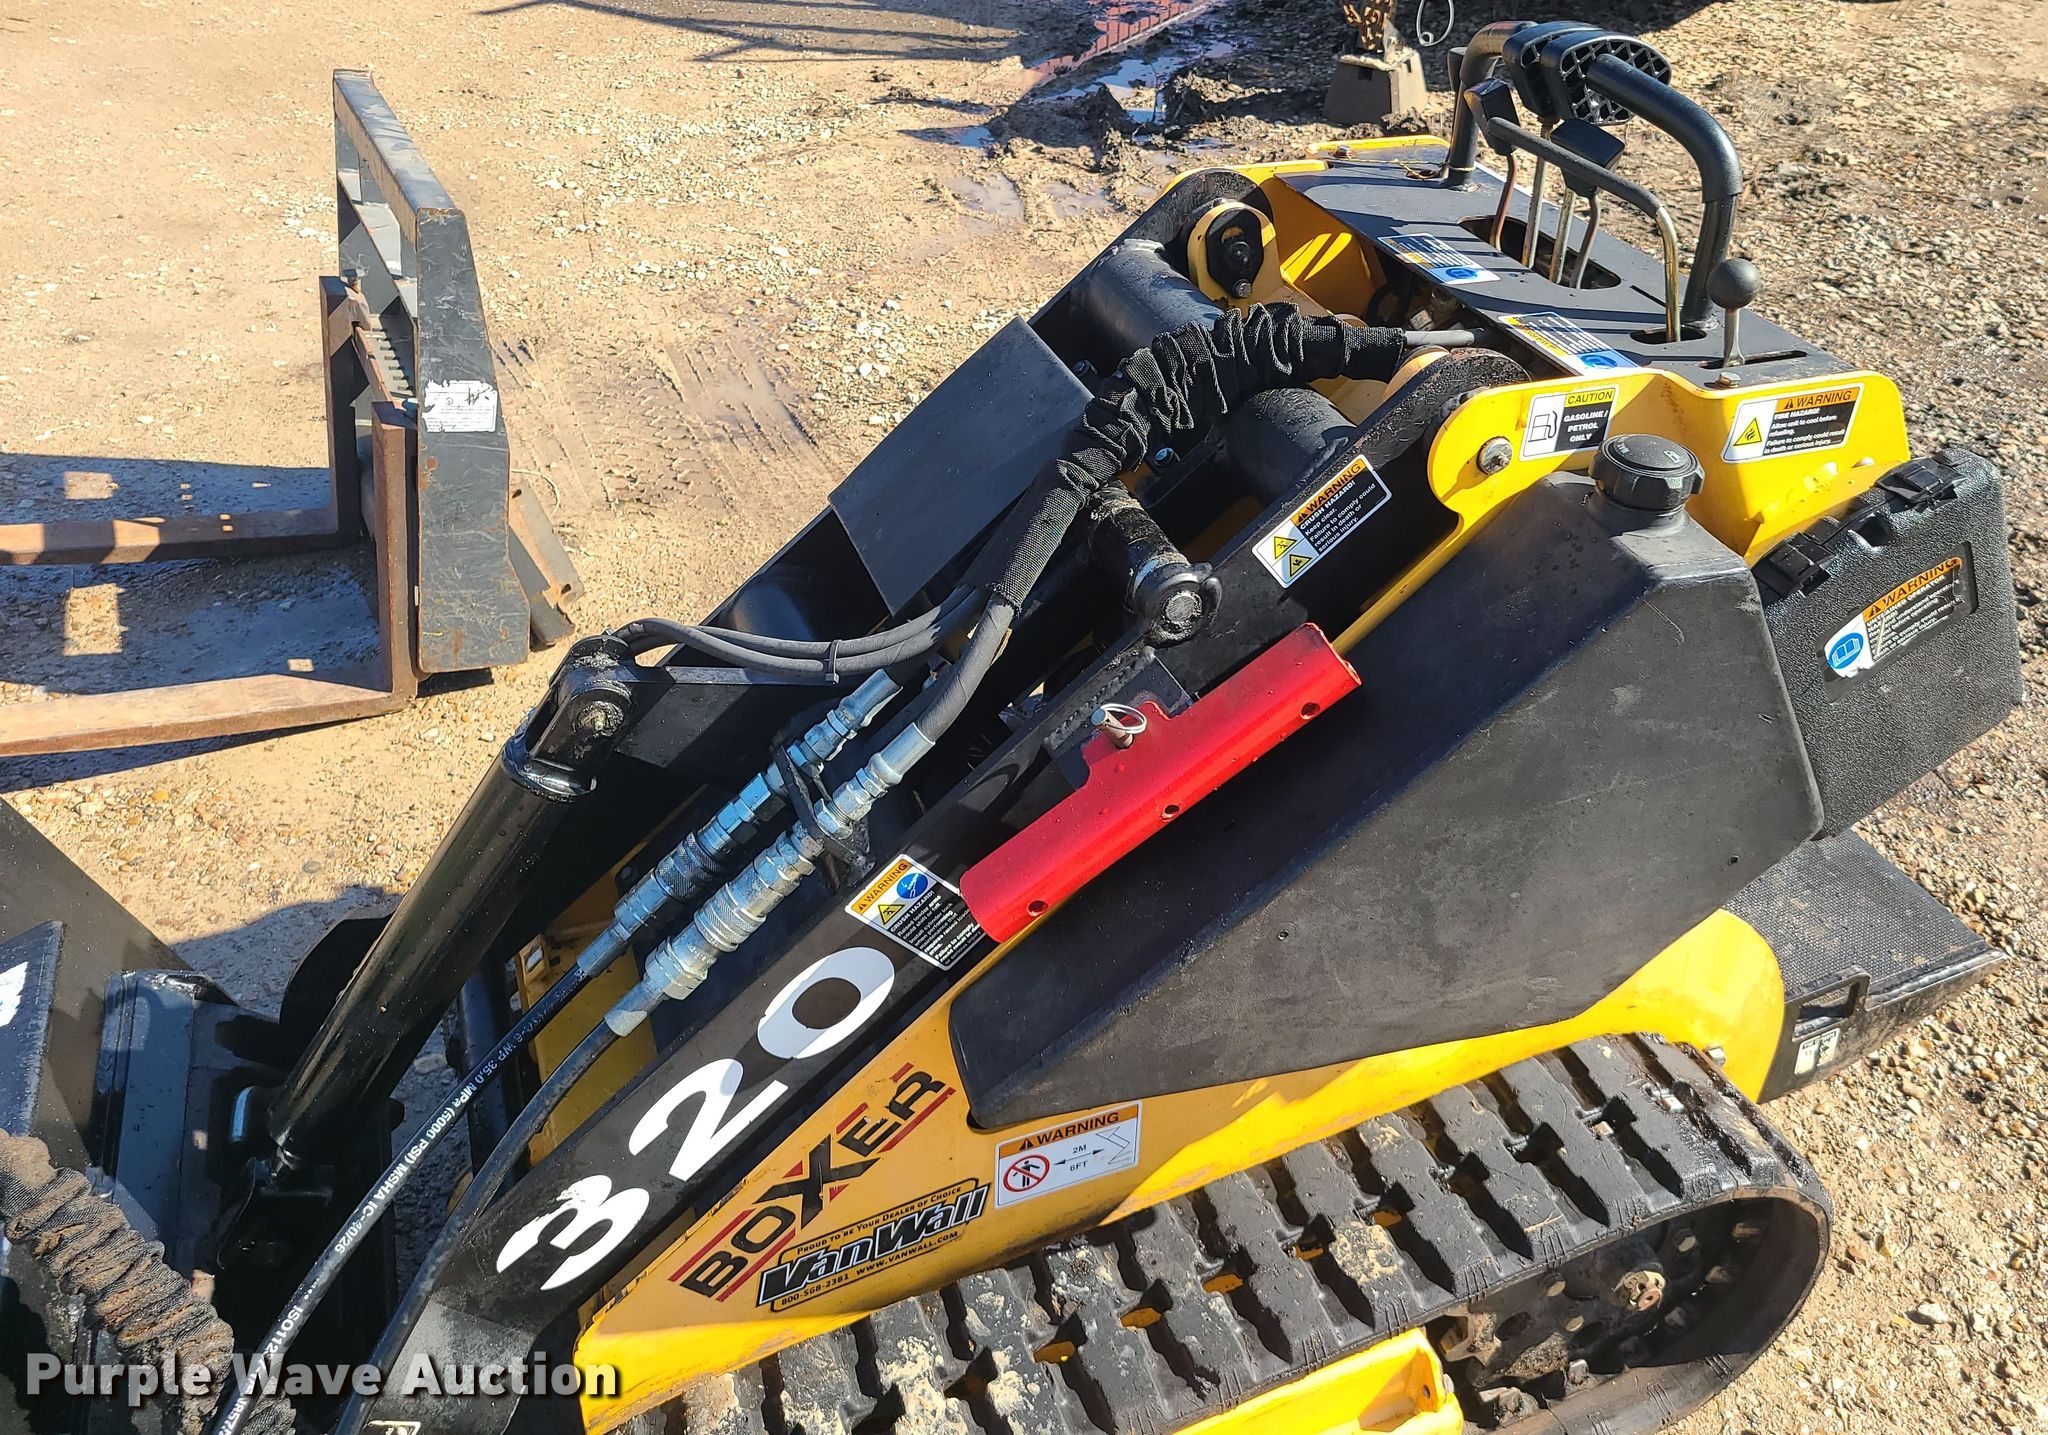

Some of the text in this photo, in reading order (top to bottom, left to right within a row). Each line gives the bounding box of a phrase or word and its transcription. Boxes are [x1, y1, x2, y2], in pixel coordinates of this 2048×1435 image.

[1568, 390, 1612, 404] CAUTION
[1796, 390, 1851, 406] WARNING
[1567, 422, 1598, 432] PETROL
[1570, 433, 1592, 442] ONLY
[1299, 480, 1355, 529] CRUSH HAZARD!
[1306, 463, 1360, 512] WARNING
[1305, 507, 1337, 535] Keep clear.
[1310, 522, 1330, 541] Failure
[1337, 497, 1359, 518] comply
[1358, 483, 1375, 499] could
[1314, 530, 1331, 546] result
[1337, 510, 1354, 525] death
[1318, 516, 1358, 551] serious injury.
[1883, 557, 1956, 606] WARNING
[1906, 574, 1945, 600] OPERATOR
[864, 862, 907, 903] WARNING
[890, 890, 934, 932] CRUSH HAZARD!
[897, 894, 941, 936] Raised loader arms
[902, 925, 916, 939] could
[915, 915, 927, 926] shift
[908, 902, 952, 943] Install cylinder lock
[914, 909, 953, 946] when performing
[919, 912, 957, 949] maintenance that
[923, 908, 970, 953] requires raised loade
[934, 943, 951, 959] Failure
[956, 922, 974, 940] comply
[494, 1040, 514, 1061] WP
[450, 1081, 477, 1110] MPa
[423, 1105, 456, 1141] (5000
[496, 946, 895, 1291] 320
[1037, 1112, 1119, 1145] WARNING
[402, 1136, 429, 1164] PSI)
[1070, 1161, 1088, 1171] 6FT
[1073, 1144, 1087, 1153] 2M
[372, 1162, 408, 1202] MSHA
[680, 1070, 947, 1298] BOXER
[756, 1183, 991, 1307] VanWall
[781, 1274, 849, 1305] 800-568-2381
